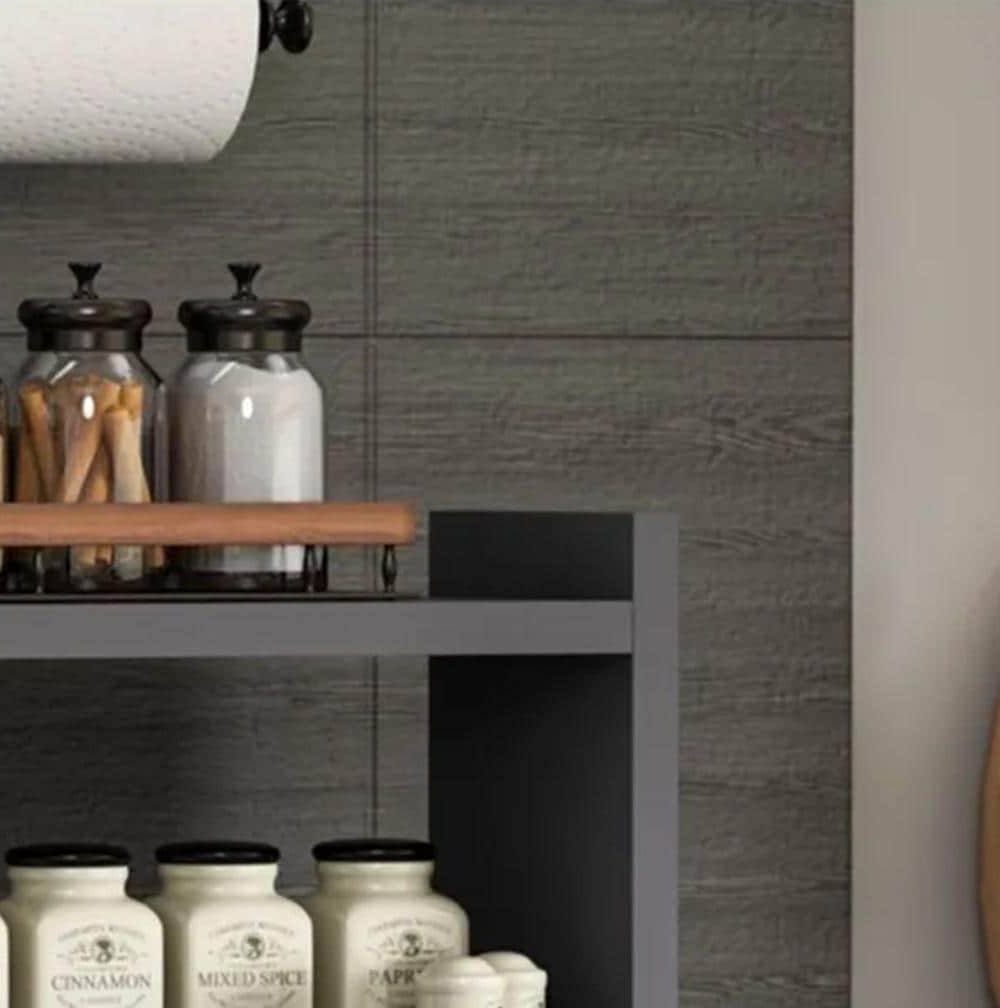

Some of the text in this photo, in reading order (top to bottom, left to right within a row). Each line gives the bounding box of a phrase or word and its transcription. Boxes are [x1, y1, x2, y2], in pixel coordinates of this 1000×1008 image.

[51, 974, 152, 992] CINNAMON
[197, 969, 307, 988] MIXED SPICE
